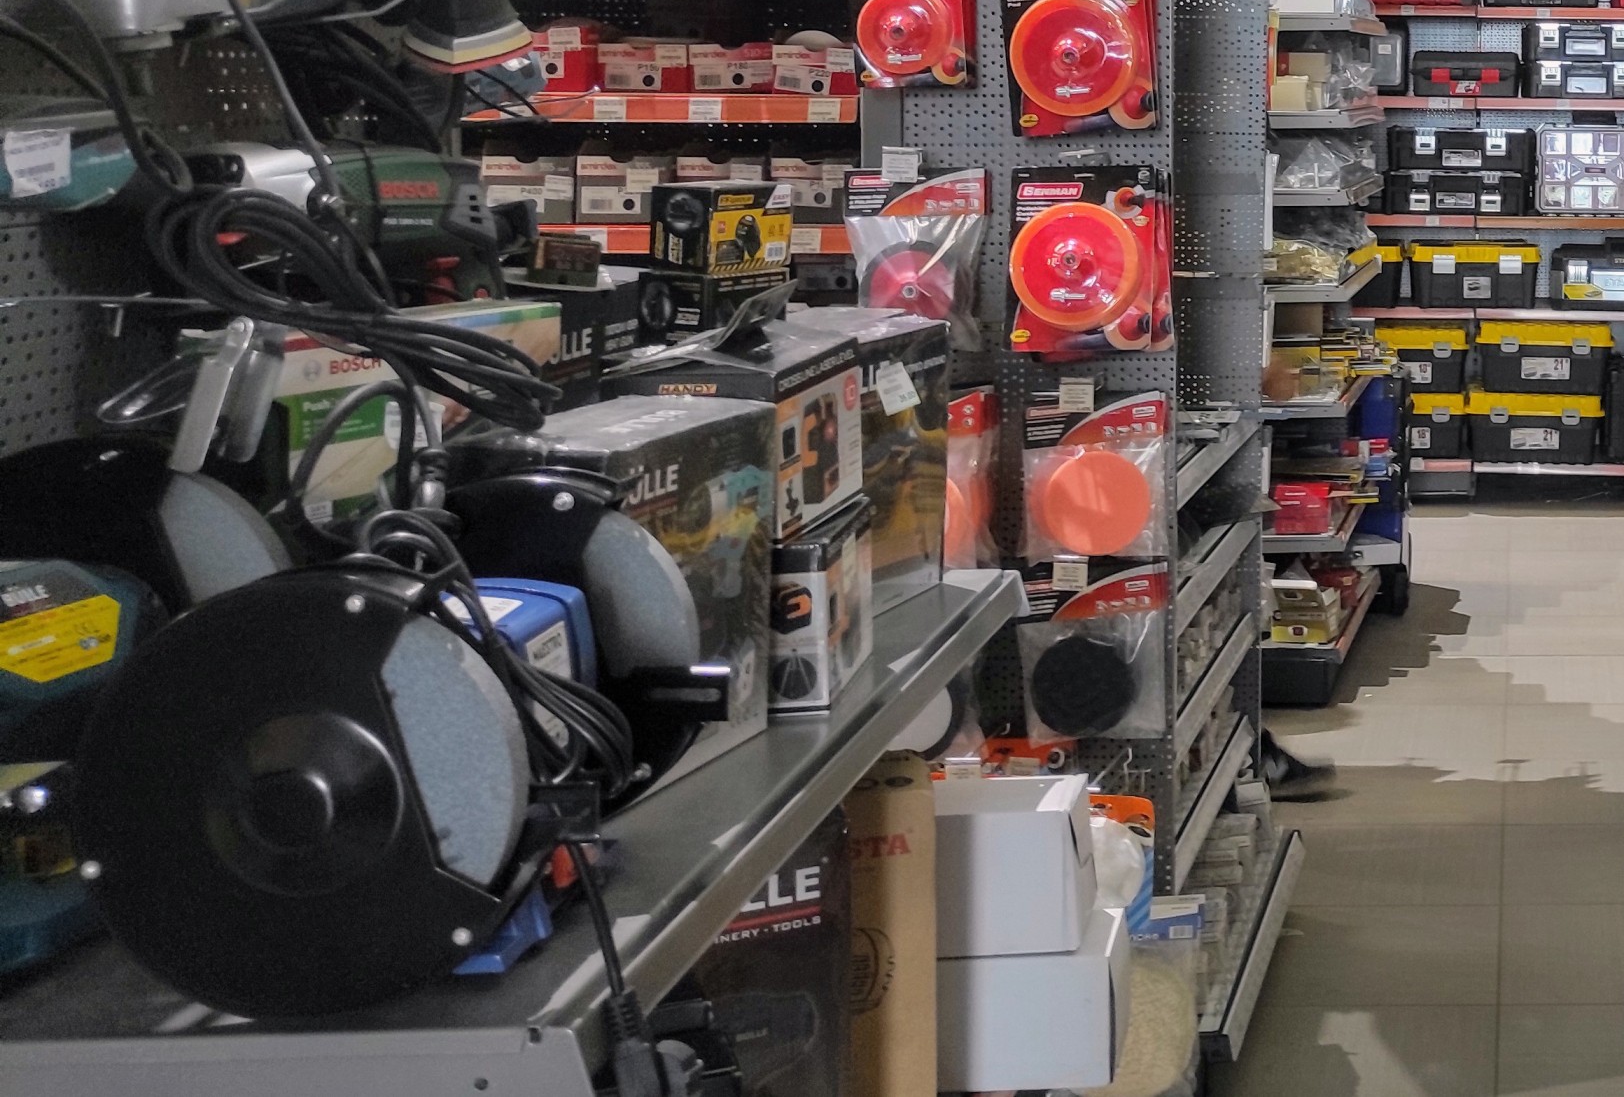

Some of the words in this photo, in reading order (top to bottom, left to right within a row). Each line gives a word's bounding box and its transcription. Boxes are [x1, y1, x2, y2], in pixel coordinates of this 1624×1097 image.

[1022, 186, 1080, 197] BENMAN
[329, 358, 382, 375] BOSCH
[659, 384, 714, 394] HANDY
[772, 915, 822, 933] TOOLS
